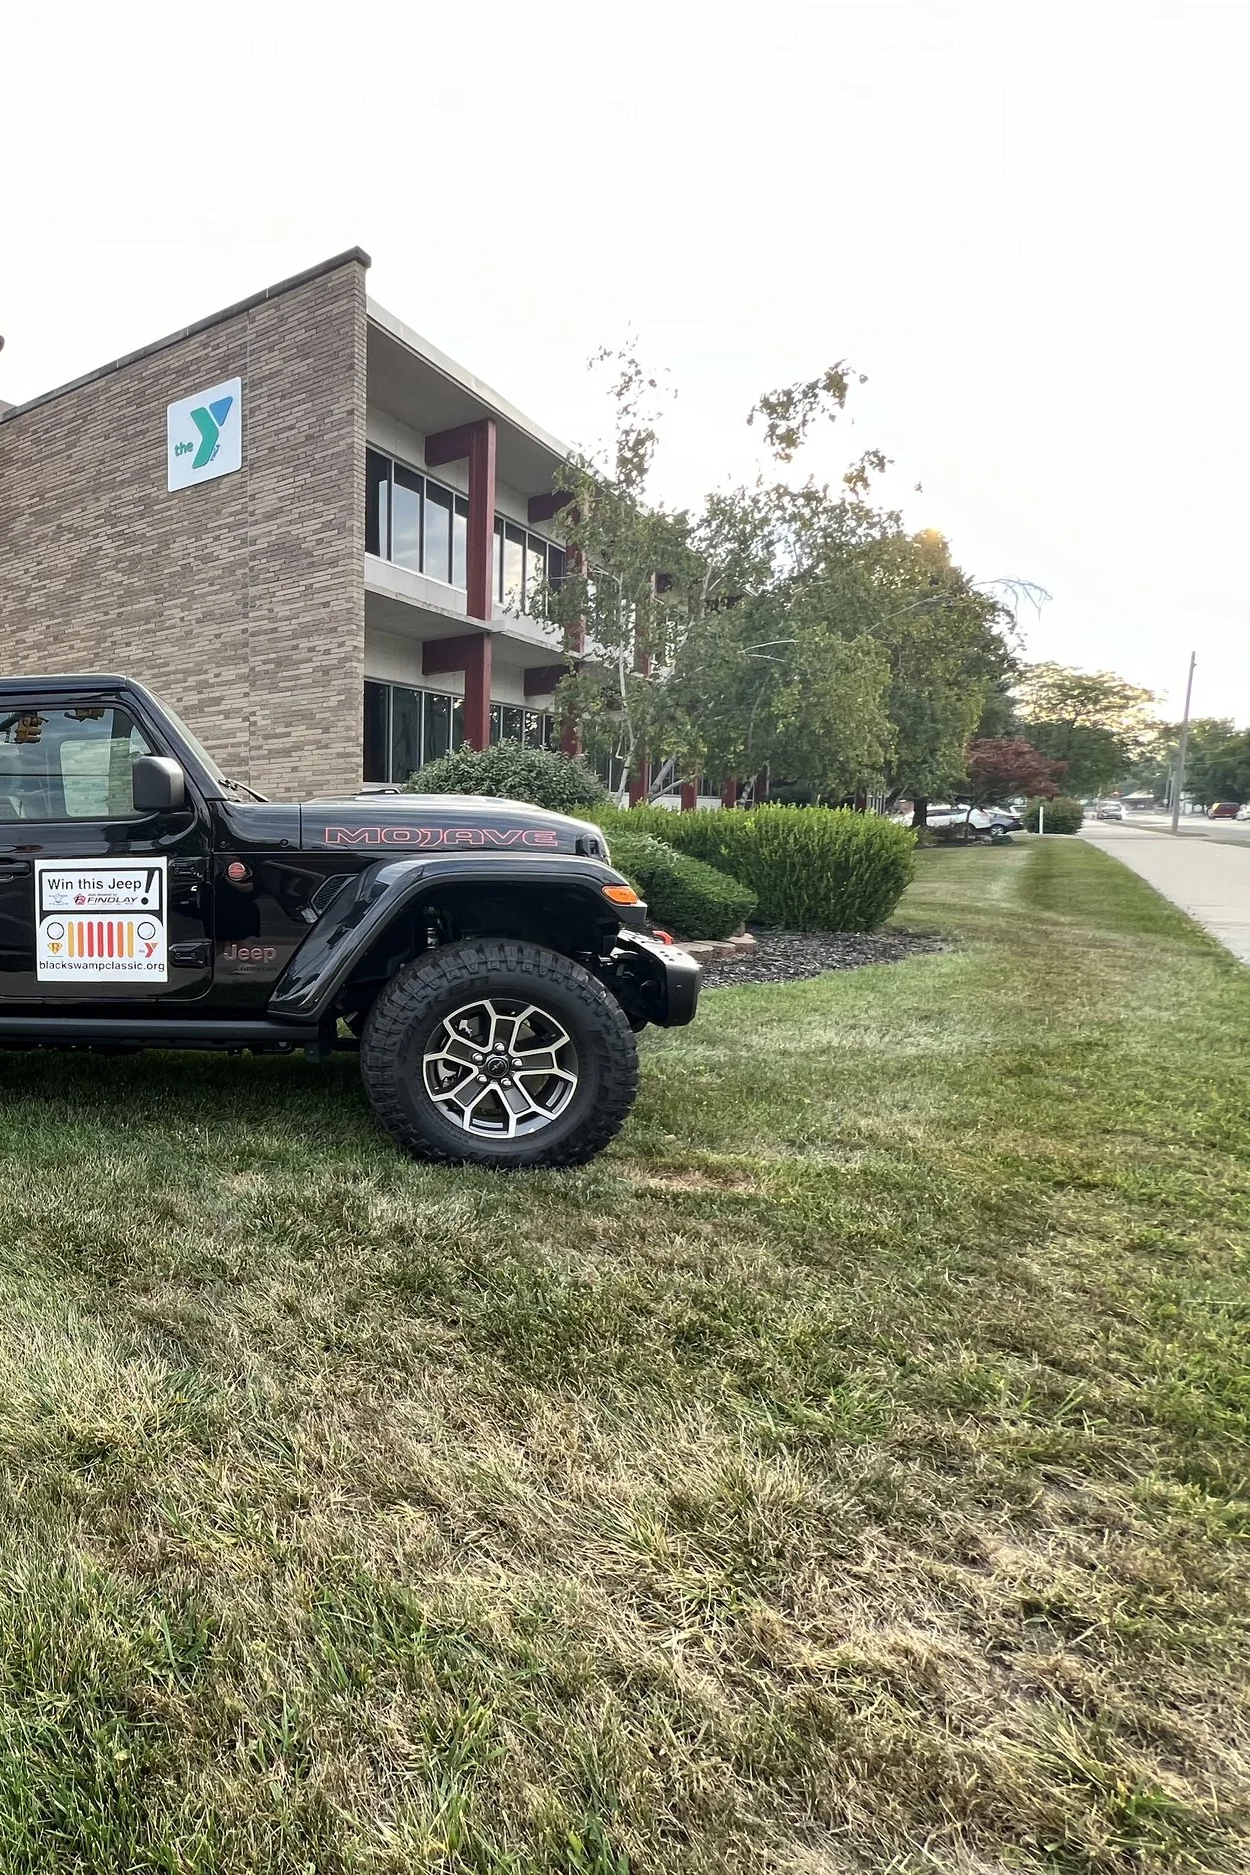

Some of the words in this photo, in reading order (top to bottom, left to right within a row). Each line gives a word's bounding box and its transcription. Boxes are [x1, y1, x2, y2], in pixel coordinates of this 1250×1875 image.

[174, 441, 194, 457] the
[325, 827, 558, 848] MOJAVE
[47, 878, 74, 890] Win
[78, 878, 104, 890] this
[222, 944, 277, 964] Jeep
[39, 961, 165, 972] blackswampclassic.org
